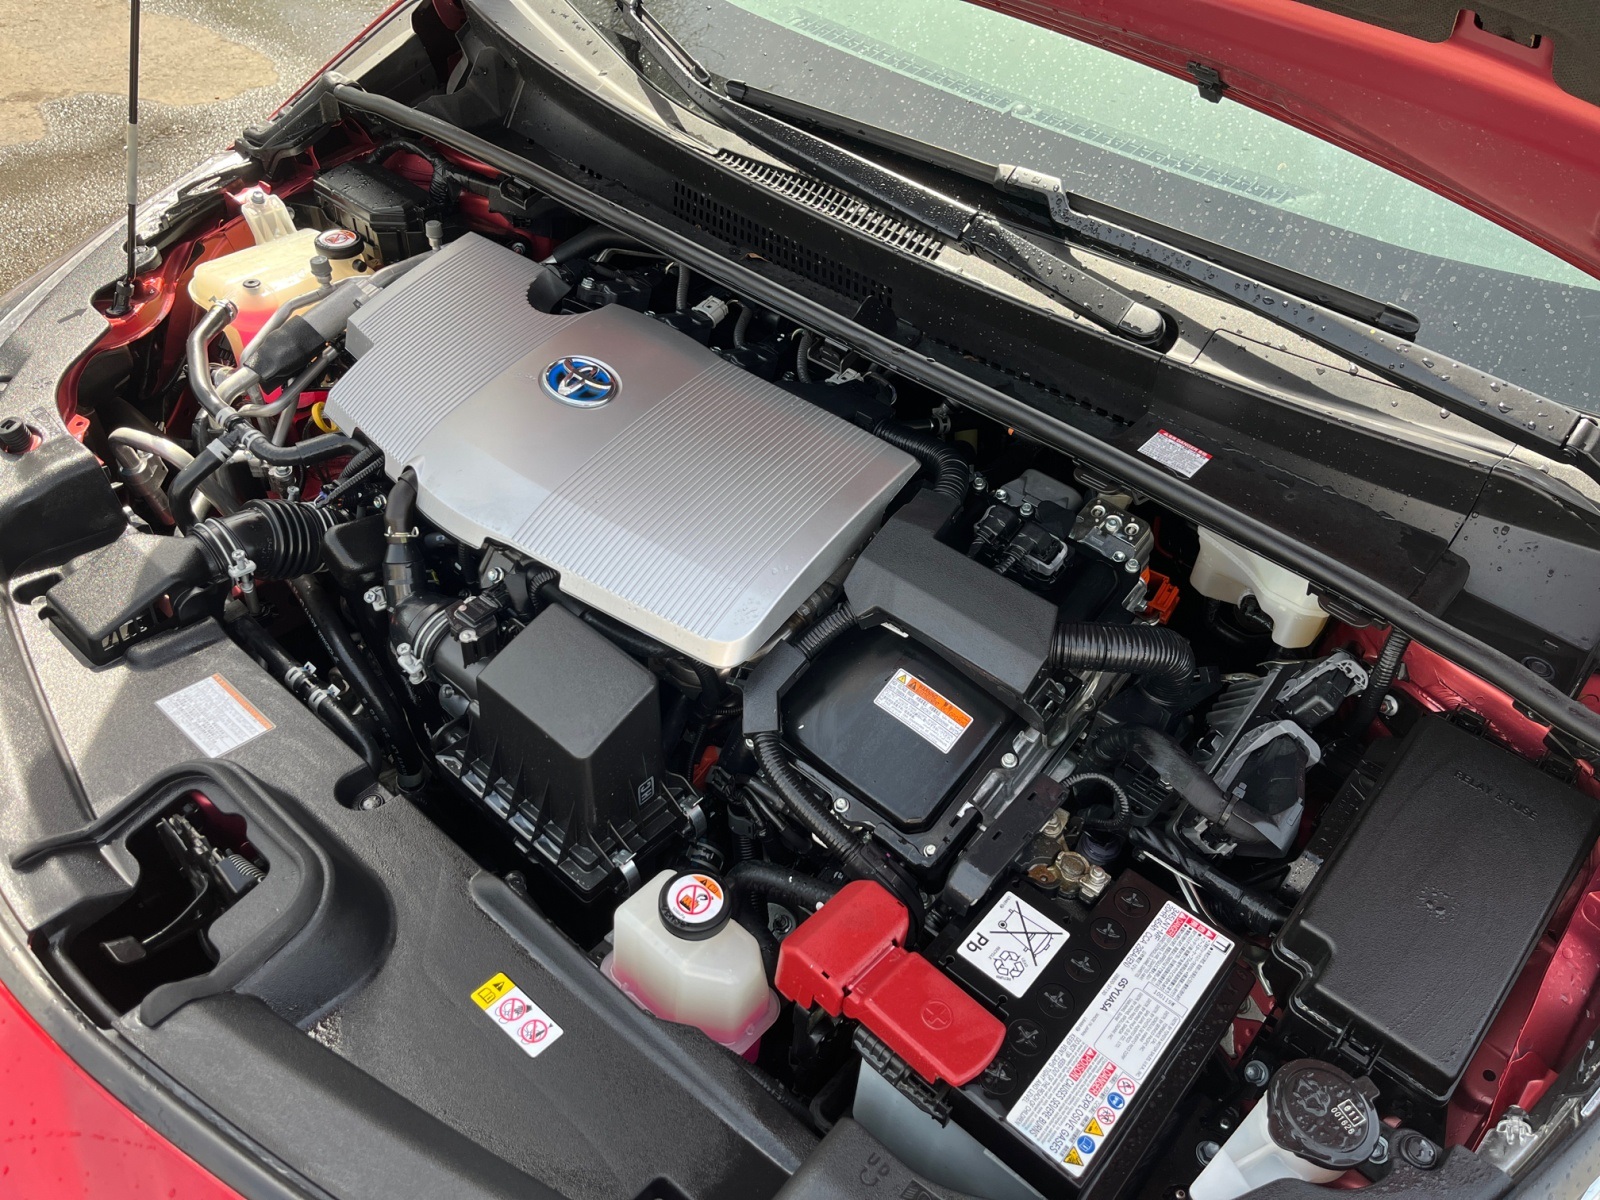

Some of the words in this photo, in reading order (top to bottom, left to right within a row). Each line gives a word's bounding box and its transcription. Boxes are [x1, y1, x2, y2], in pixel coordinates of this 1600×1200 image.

[1176, 438, 1199, 452] DANGER
[641, 781, 652, 801] HC
[1453, 761, 1493, 796] RELAY
[1506, 798, 1539, 822] FUSE
[1159, 903, 1174, 919] 20HR
[1150, 917, 1163, 931] 45Ah
[1166, 917, 1184, 937] DANGER
[966, 932, 989, 952] Pb
[1140, 931, 1153, 945] CCA
[988, 946, 1001, 960] RECYCLE
[1117, 977, 1129, 989] GS
[1100, 987, 1123, 1012] YUASA
[1091, 1013, 1099, 1023] MADE
[1080, 1025, 1089, 1036] JAPAN
[1066, 1033, 1076, 1046] KEEP
[1074, 1037, 1082, 1045] DO
[1058, 1044, 1068, 1057] VENT
[1048, 1054, 1060, 1068] CAPS
[1057, 1058, 1066, 1069] KEEP
[1069, 1053, 1092, 1081] POISON
[1040, 1067, 1052, 1081] TIGHT
[1047, 1074, 1054, 1082] OF
[1051, 1067, 1060, 1077] OUT
[1032, 1079, 1042, 1090] AND
[1041, 1080, 1051, 1090] THE
[1055, 1078, 1074, 1100] CAUSES
[1089, 1068, 1112, 1096] DANGER
[1021, 1088, 1035, 1103] LEVEL
[1032, 1088, 1045, 1102] REACH
[1029, 1100, 1036, 1108] OF
[1041, 1097, 1061, 1120] SEVERE
[1014, 1105, 1032, 1126] CHILDREN
[1065, 1093, 1094, 1131] EXPLOSIVE
[1029, 1116, 1047, 1137] BURNS
[1049, 1129, 1070, 1154] GASES
